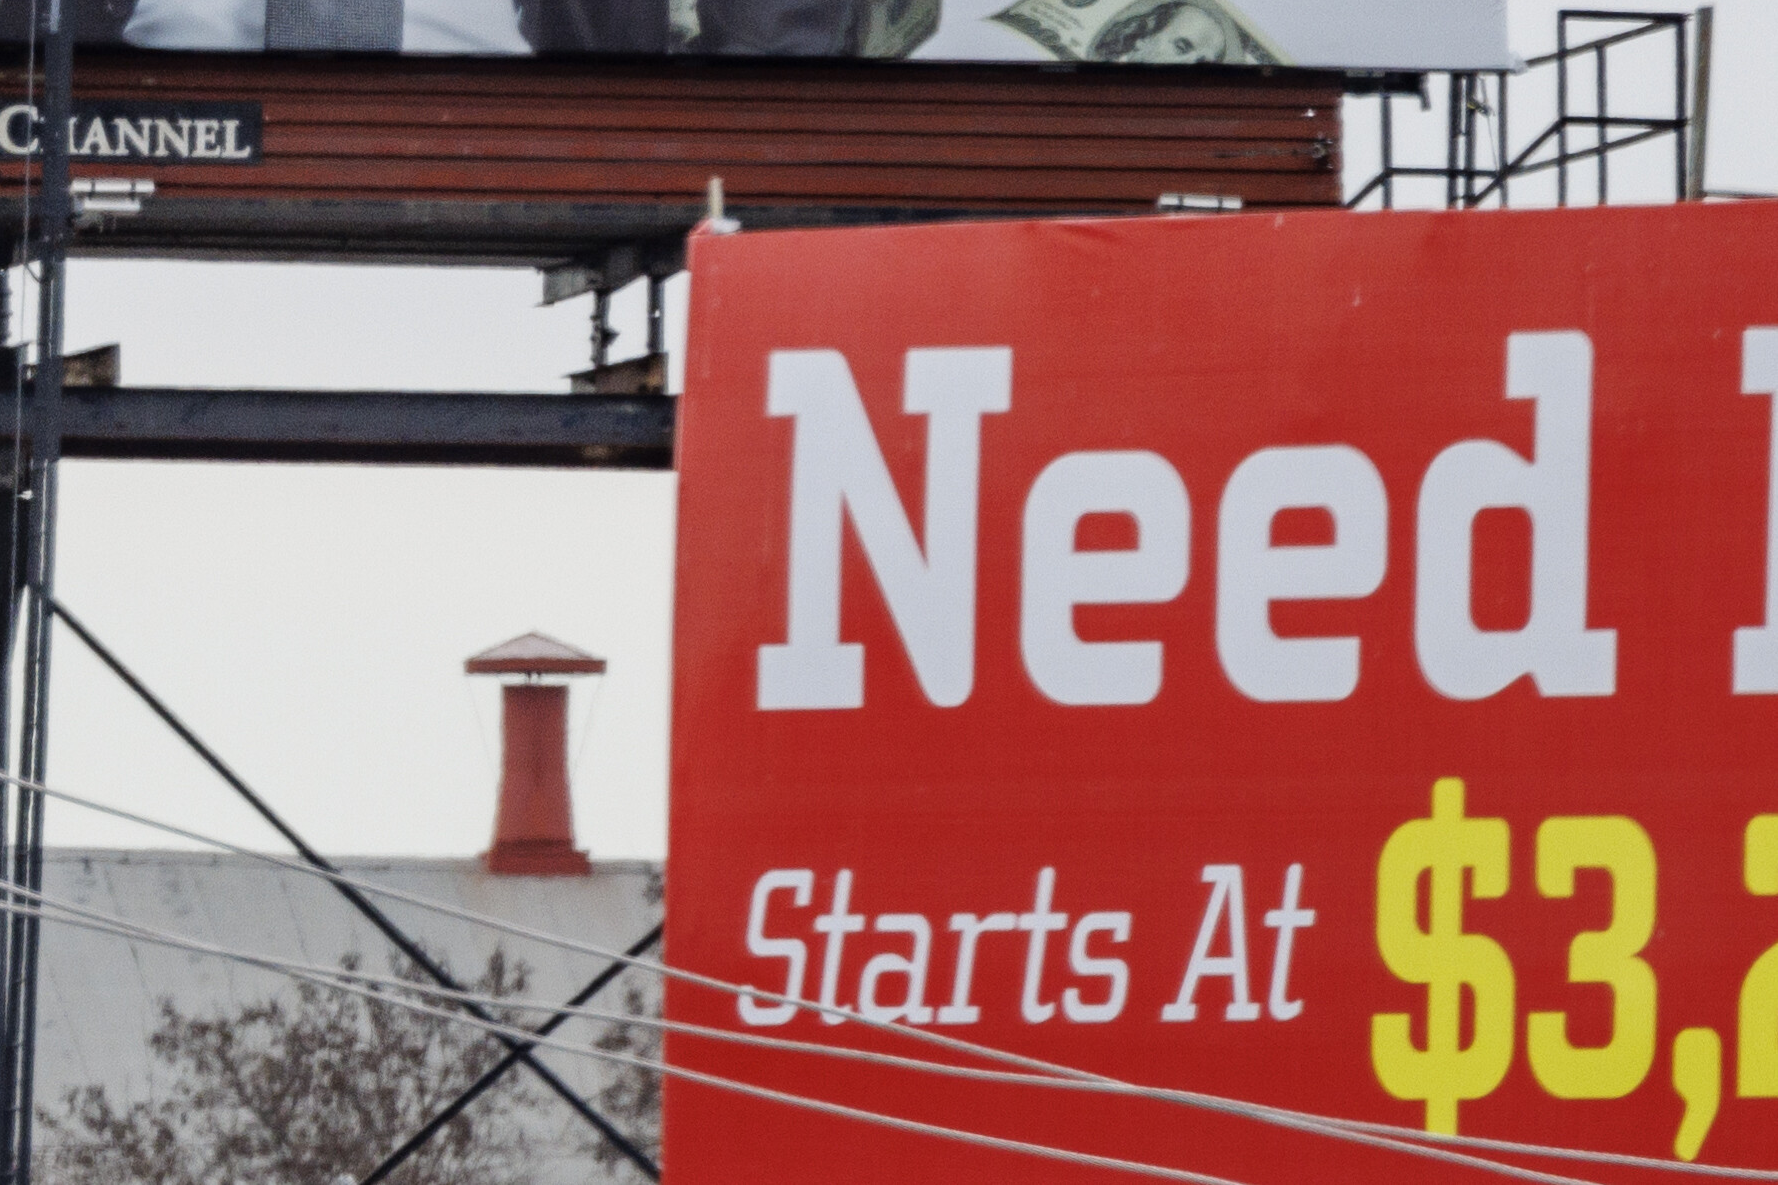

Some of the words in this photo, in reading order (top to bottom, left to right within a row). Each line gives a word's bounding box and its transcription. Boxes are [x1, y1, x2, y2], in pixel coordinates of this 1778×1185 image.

[756, 329, 1618, 711] Need
[736, 867, 1131, 1026] Starts
[1161, 863, 1315, 1021] At
